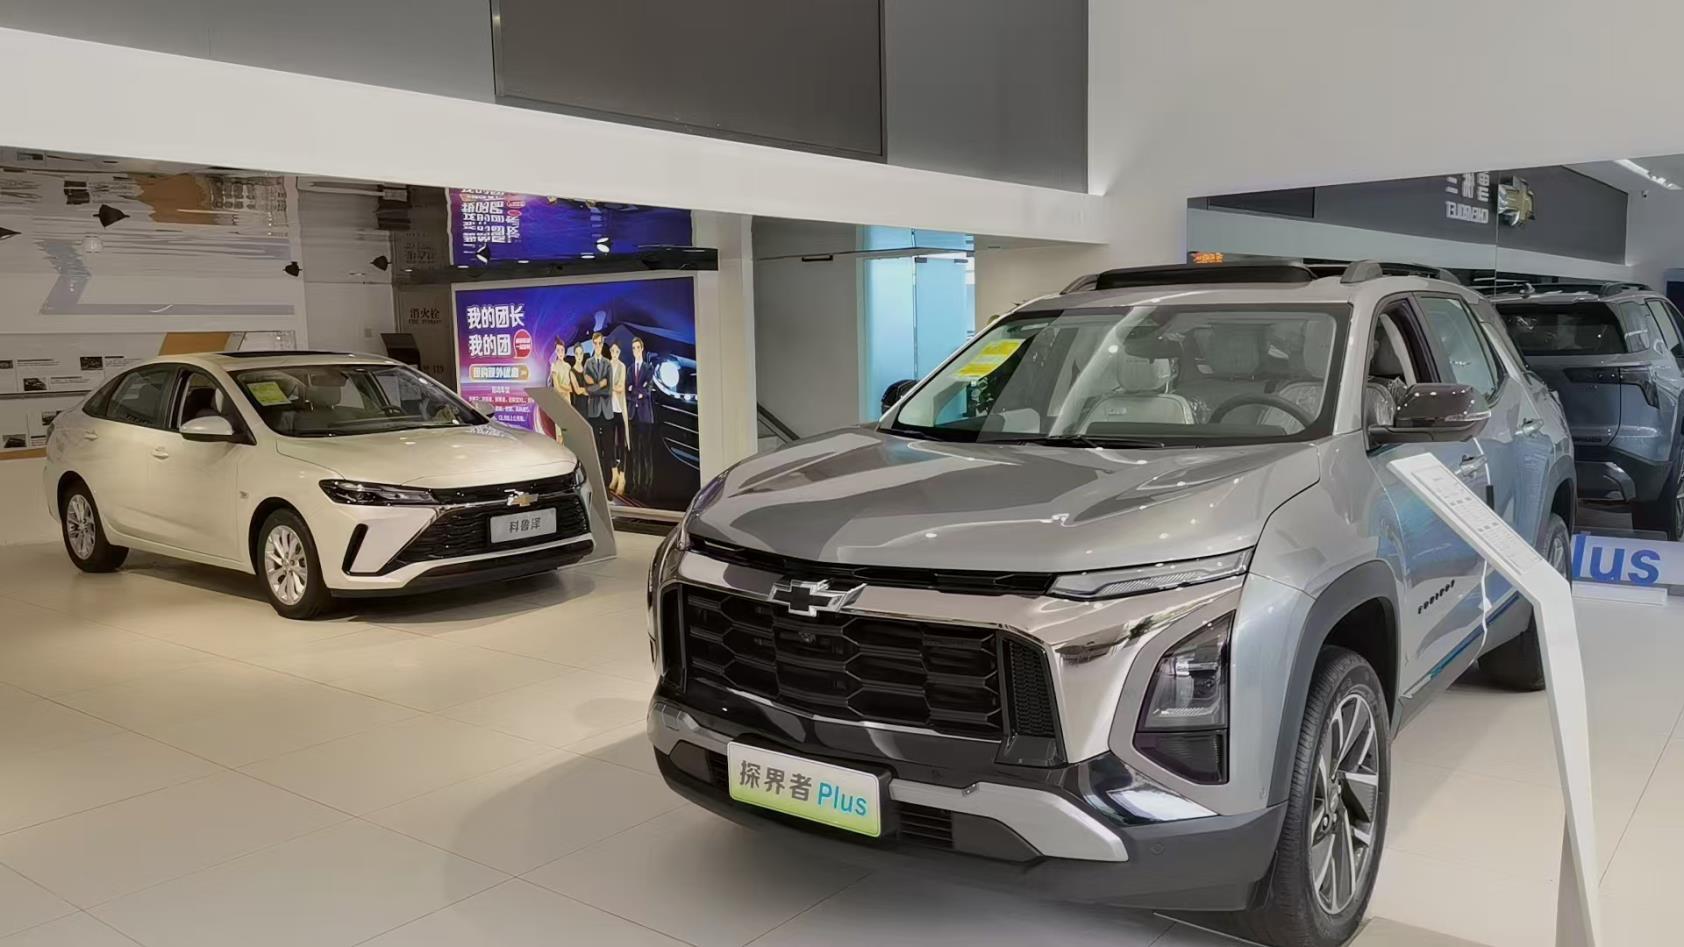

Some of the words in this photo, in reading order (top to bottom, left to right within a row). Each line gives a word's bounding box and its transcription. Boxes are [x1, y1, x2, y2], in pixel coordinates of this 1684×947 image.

[467, 305, 525, 329] 我的团长
[469, 334, 512, 356] 我的团
[1572, 533, 1660, 585] lus
[739, 760, 812, 802] 探界者
[817, 782, 867, 816] Plus
